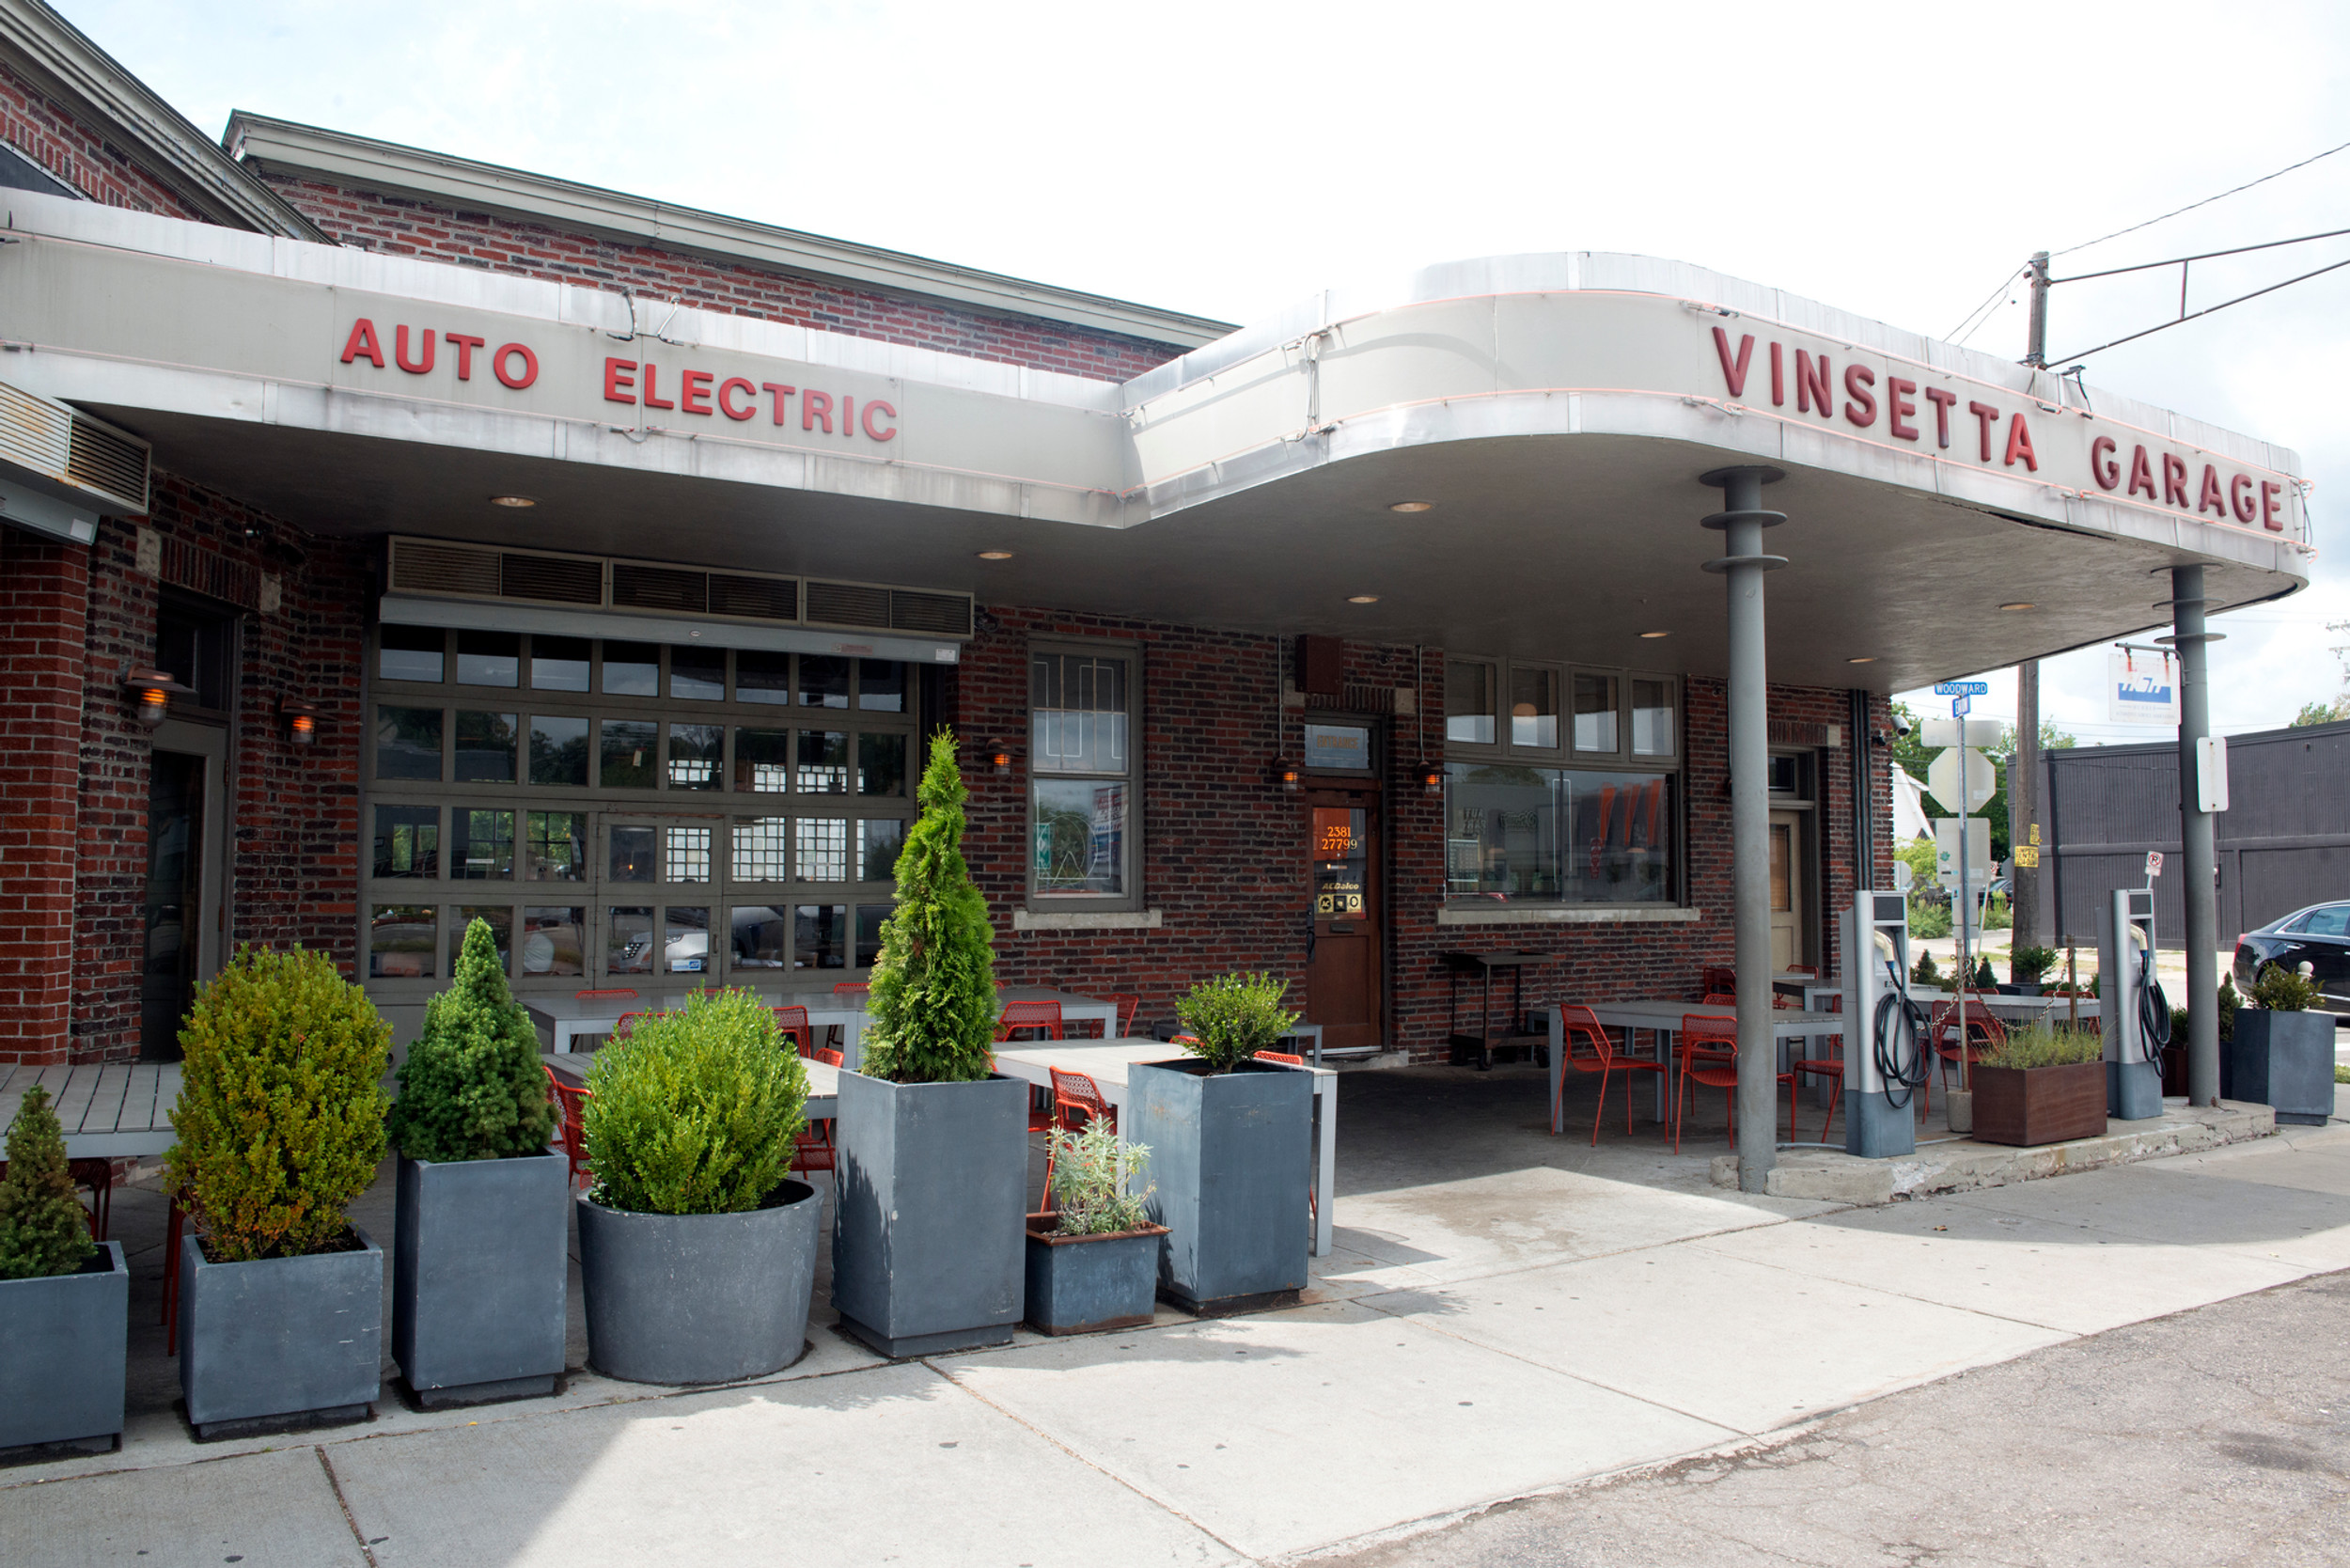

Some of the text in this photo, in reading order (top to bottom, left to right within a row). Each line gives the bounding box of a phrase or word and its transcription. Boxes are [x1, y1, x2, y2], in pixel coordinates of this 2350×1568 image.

[339, 317, 898, 442] AUTO ELECTRIC
[1711, 325, 2285, 532] VINSETTA GARAGE
[1935, 683, 1987, 694] WOODWARD
[1317, 734, 1359, 750] ENTRANCE
[1327, 826, 1351, 838] 2381
[1322, 839, 1357, 850] 27799
[1322, 883, 1360, 891] ACDelco
